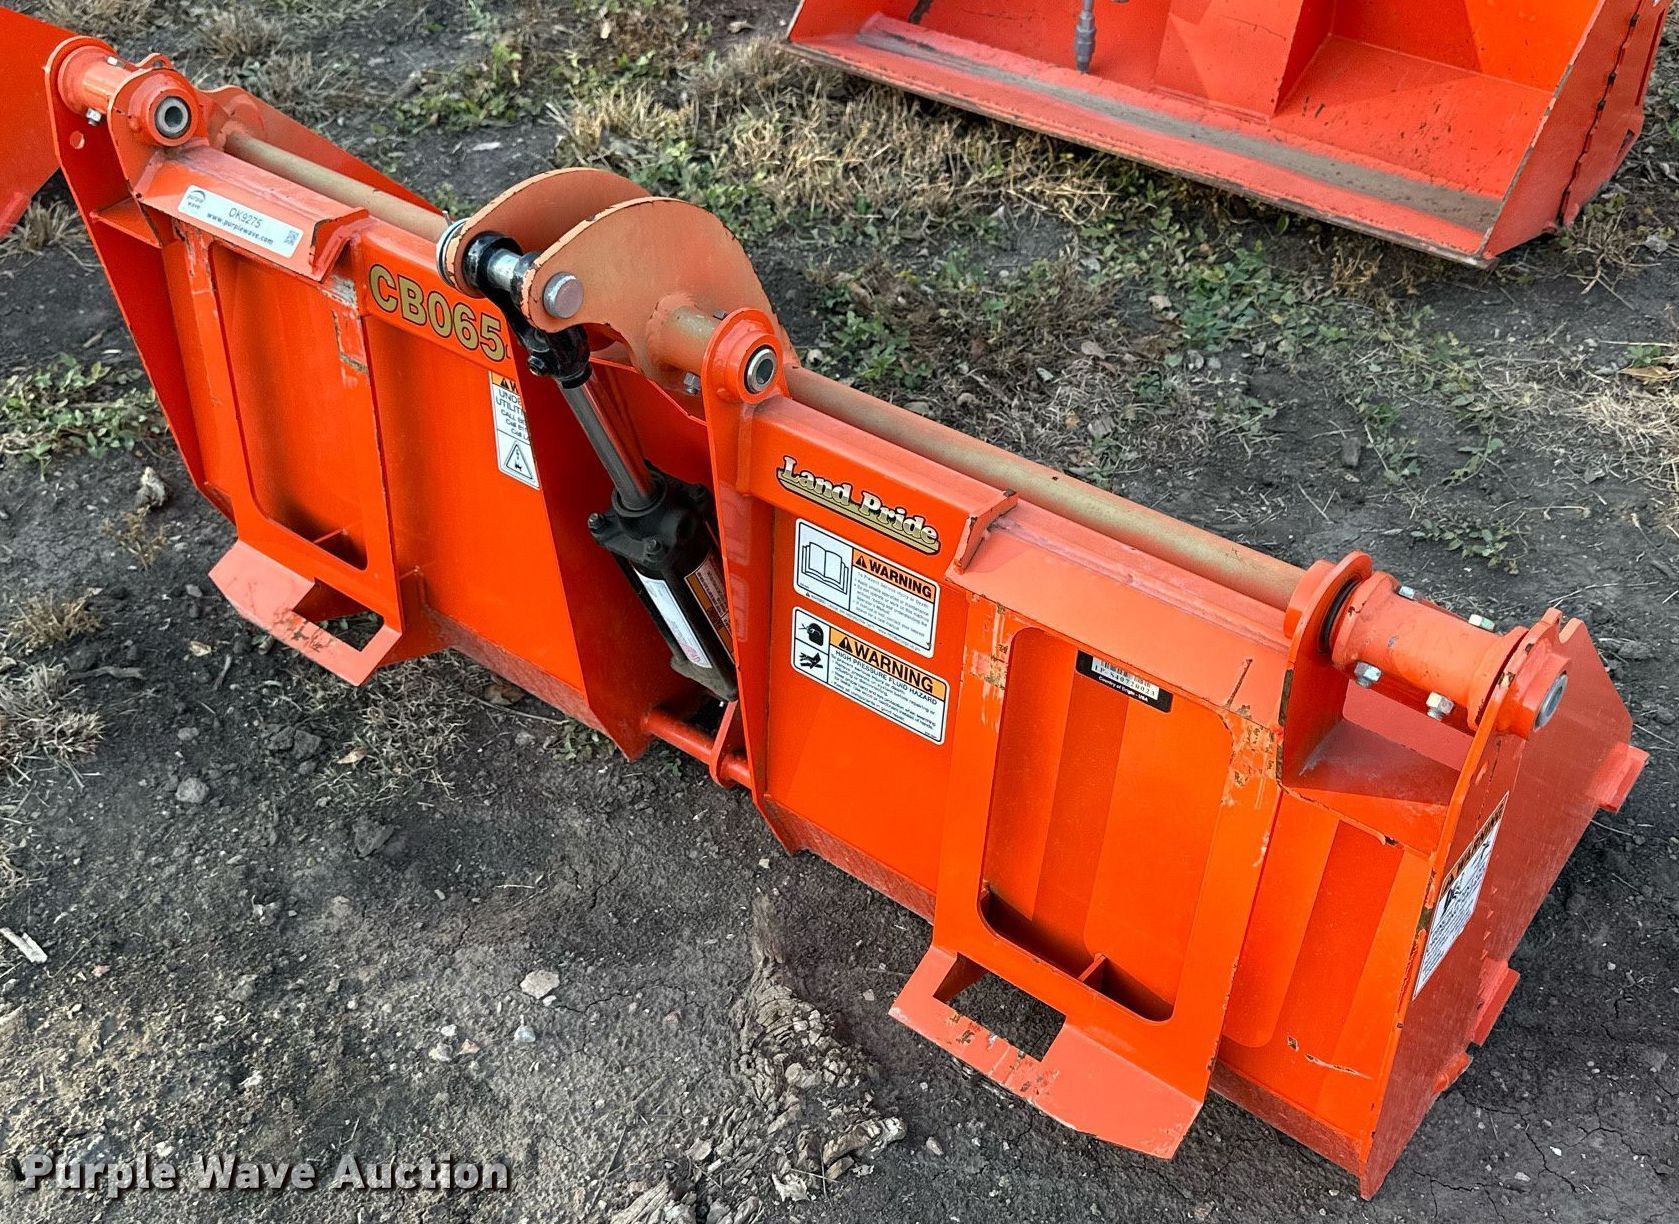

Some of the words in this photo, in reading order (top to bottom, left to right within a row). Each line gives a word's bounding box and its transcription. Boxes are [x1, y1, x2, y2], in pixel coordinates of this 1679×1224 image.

[369, 263, 510, 362] CB065
[780, 455, 852, 507] Land
[858, 490, 939, 544] Pride
[870, 560, 932, 598] WARNING
[855, 642, 933, 694] WARNING
